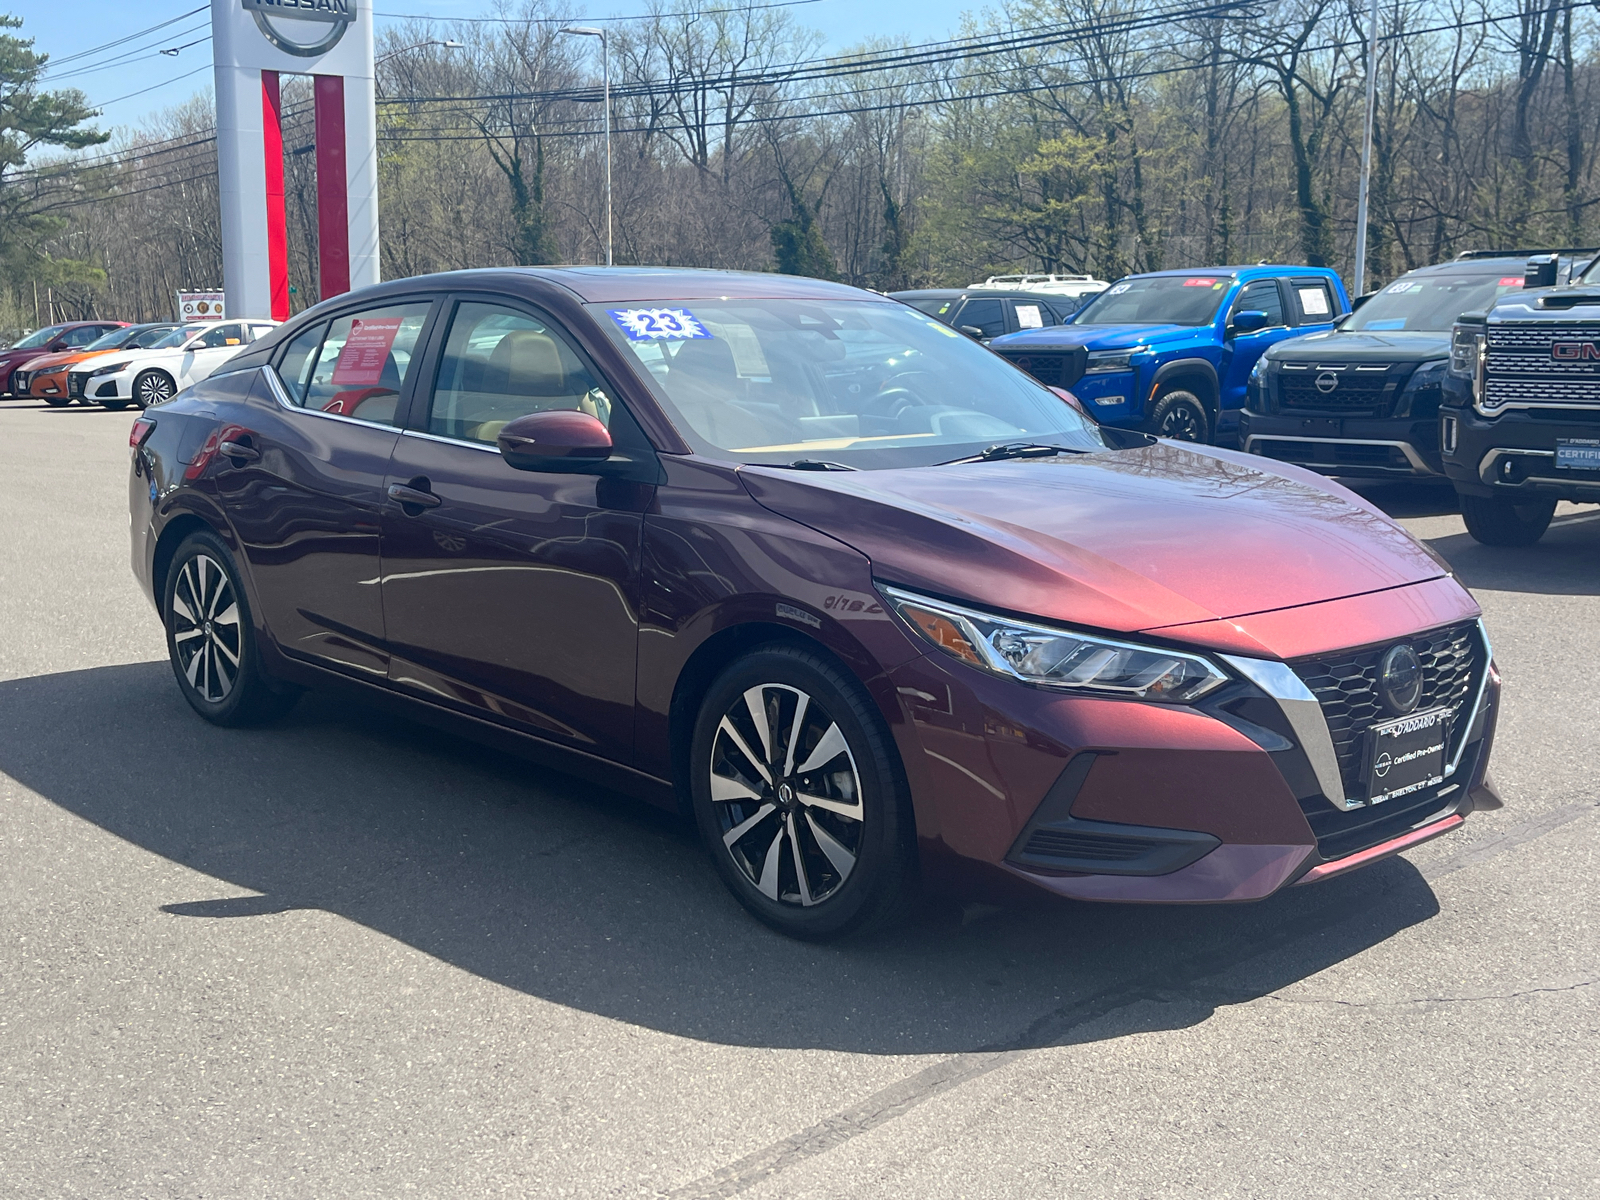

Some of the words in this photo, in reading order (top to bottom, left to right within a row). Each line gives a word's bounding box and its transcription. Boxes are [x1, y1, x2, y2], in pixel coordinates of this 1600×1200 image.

[637, 313, 683, 332] 23
[1395, 716, 1435, 736] D'ADDARIO
[1394, 752, 1416, 764] Certified
[1417, 742, 1444, 757] Pre-Owned
